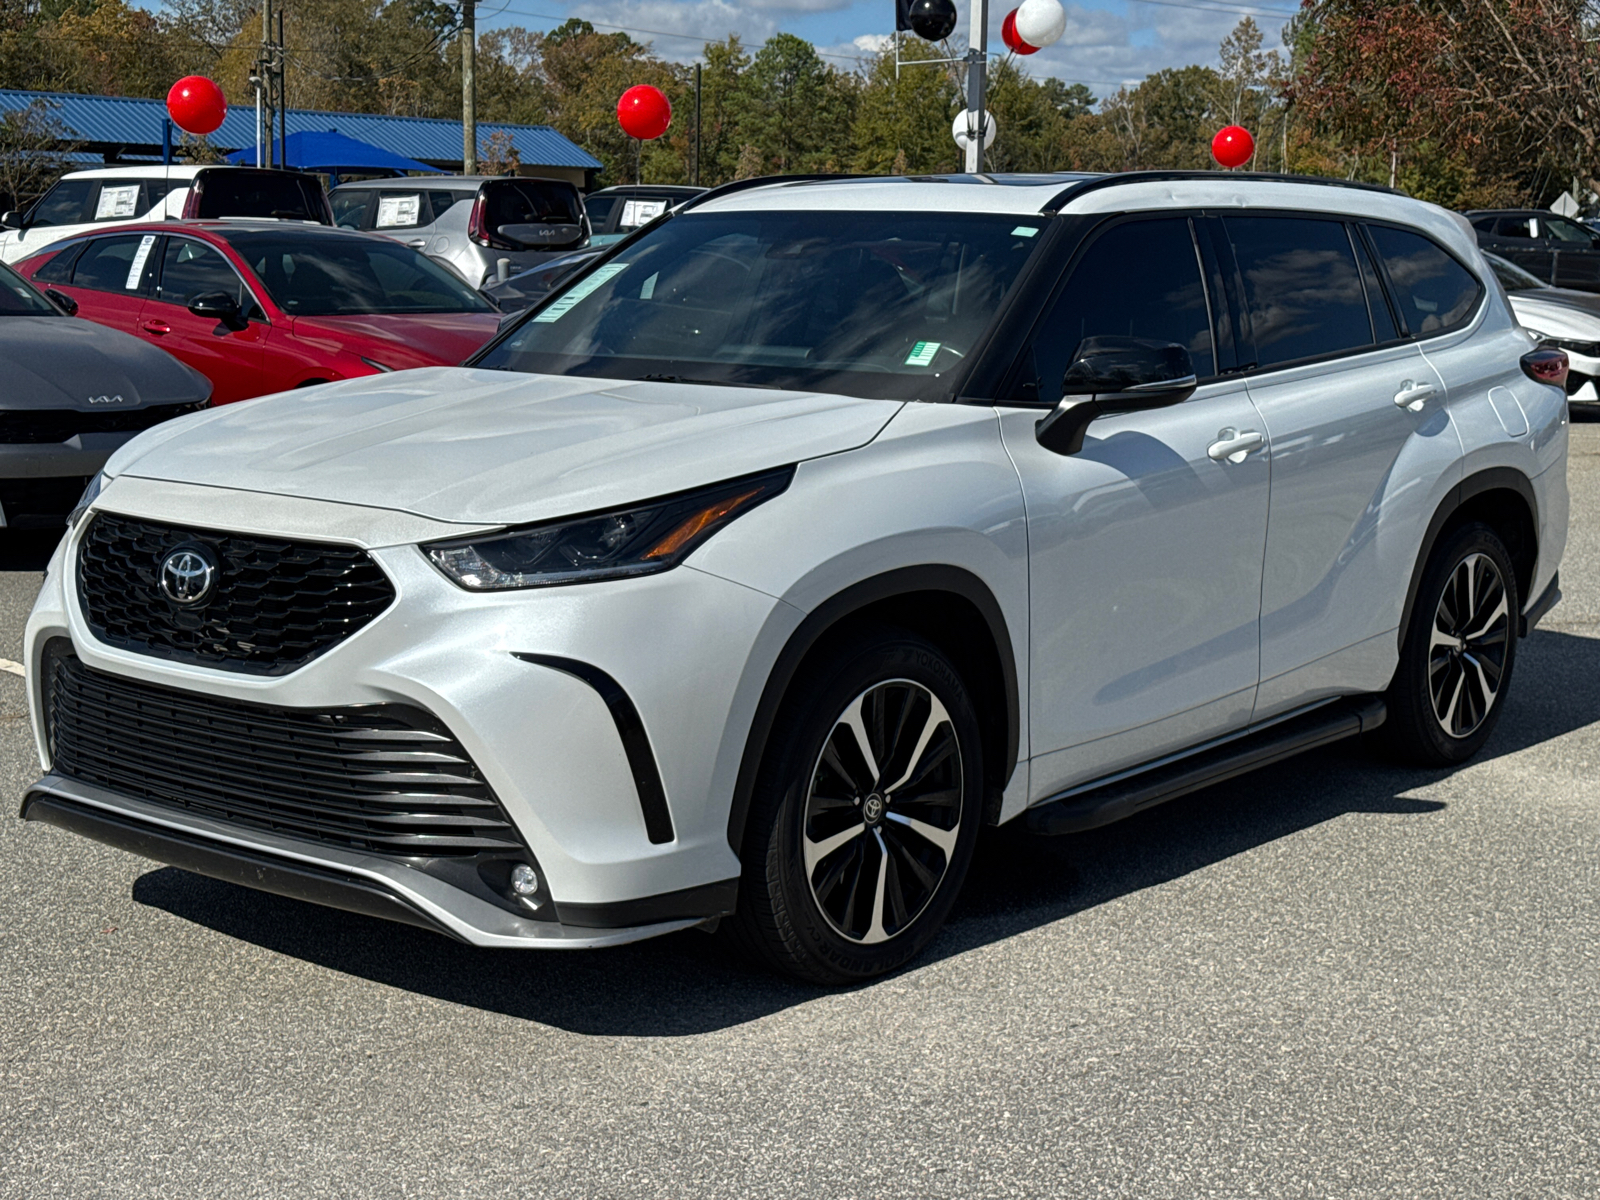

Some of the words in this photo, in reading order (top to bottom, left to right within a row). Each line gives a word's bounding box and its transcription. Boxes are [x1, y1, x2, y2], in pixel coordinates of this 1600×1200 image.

[88, 394, 124, 404] KIA
[916, 649, 963, 703] YOKOHAMA
[818, 941, 914, 973] GEOLANDAR
